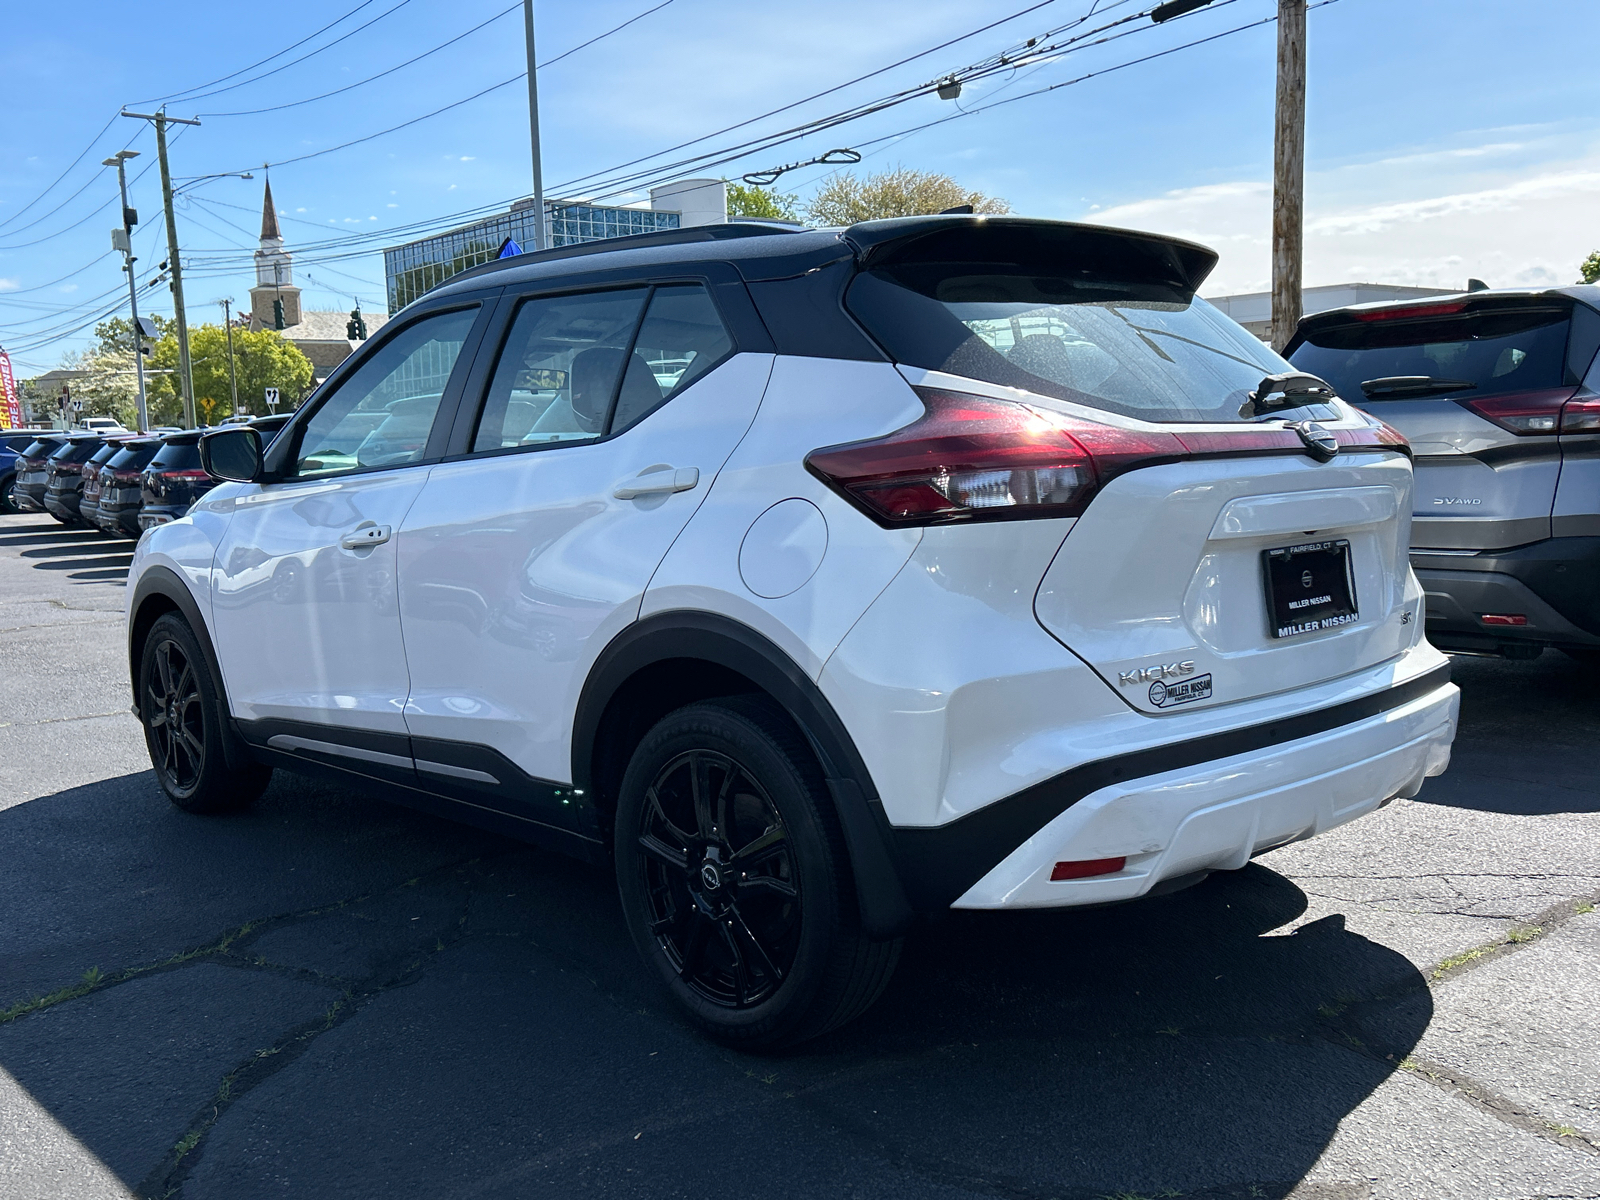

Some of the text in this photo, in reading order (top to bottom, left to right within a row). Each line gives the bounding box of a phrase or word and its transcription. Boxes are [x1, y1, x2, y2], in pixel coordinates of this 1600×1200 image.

[1288, 595, 1332, 610] MILLER NISSAN
[1278, 613, 1359, 638] MILLER NISSAN
[1118, 660, 1195, 687] KICKS
[1167, 680, 1212, 698] MILLER NISSAN
